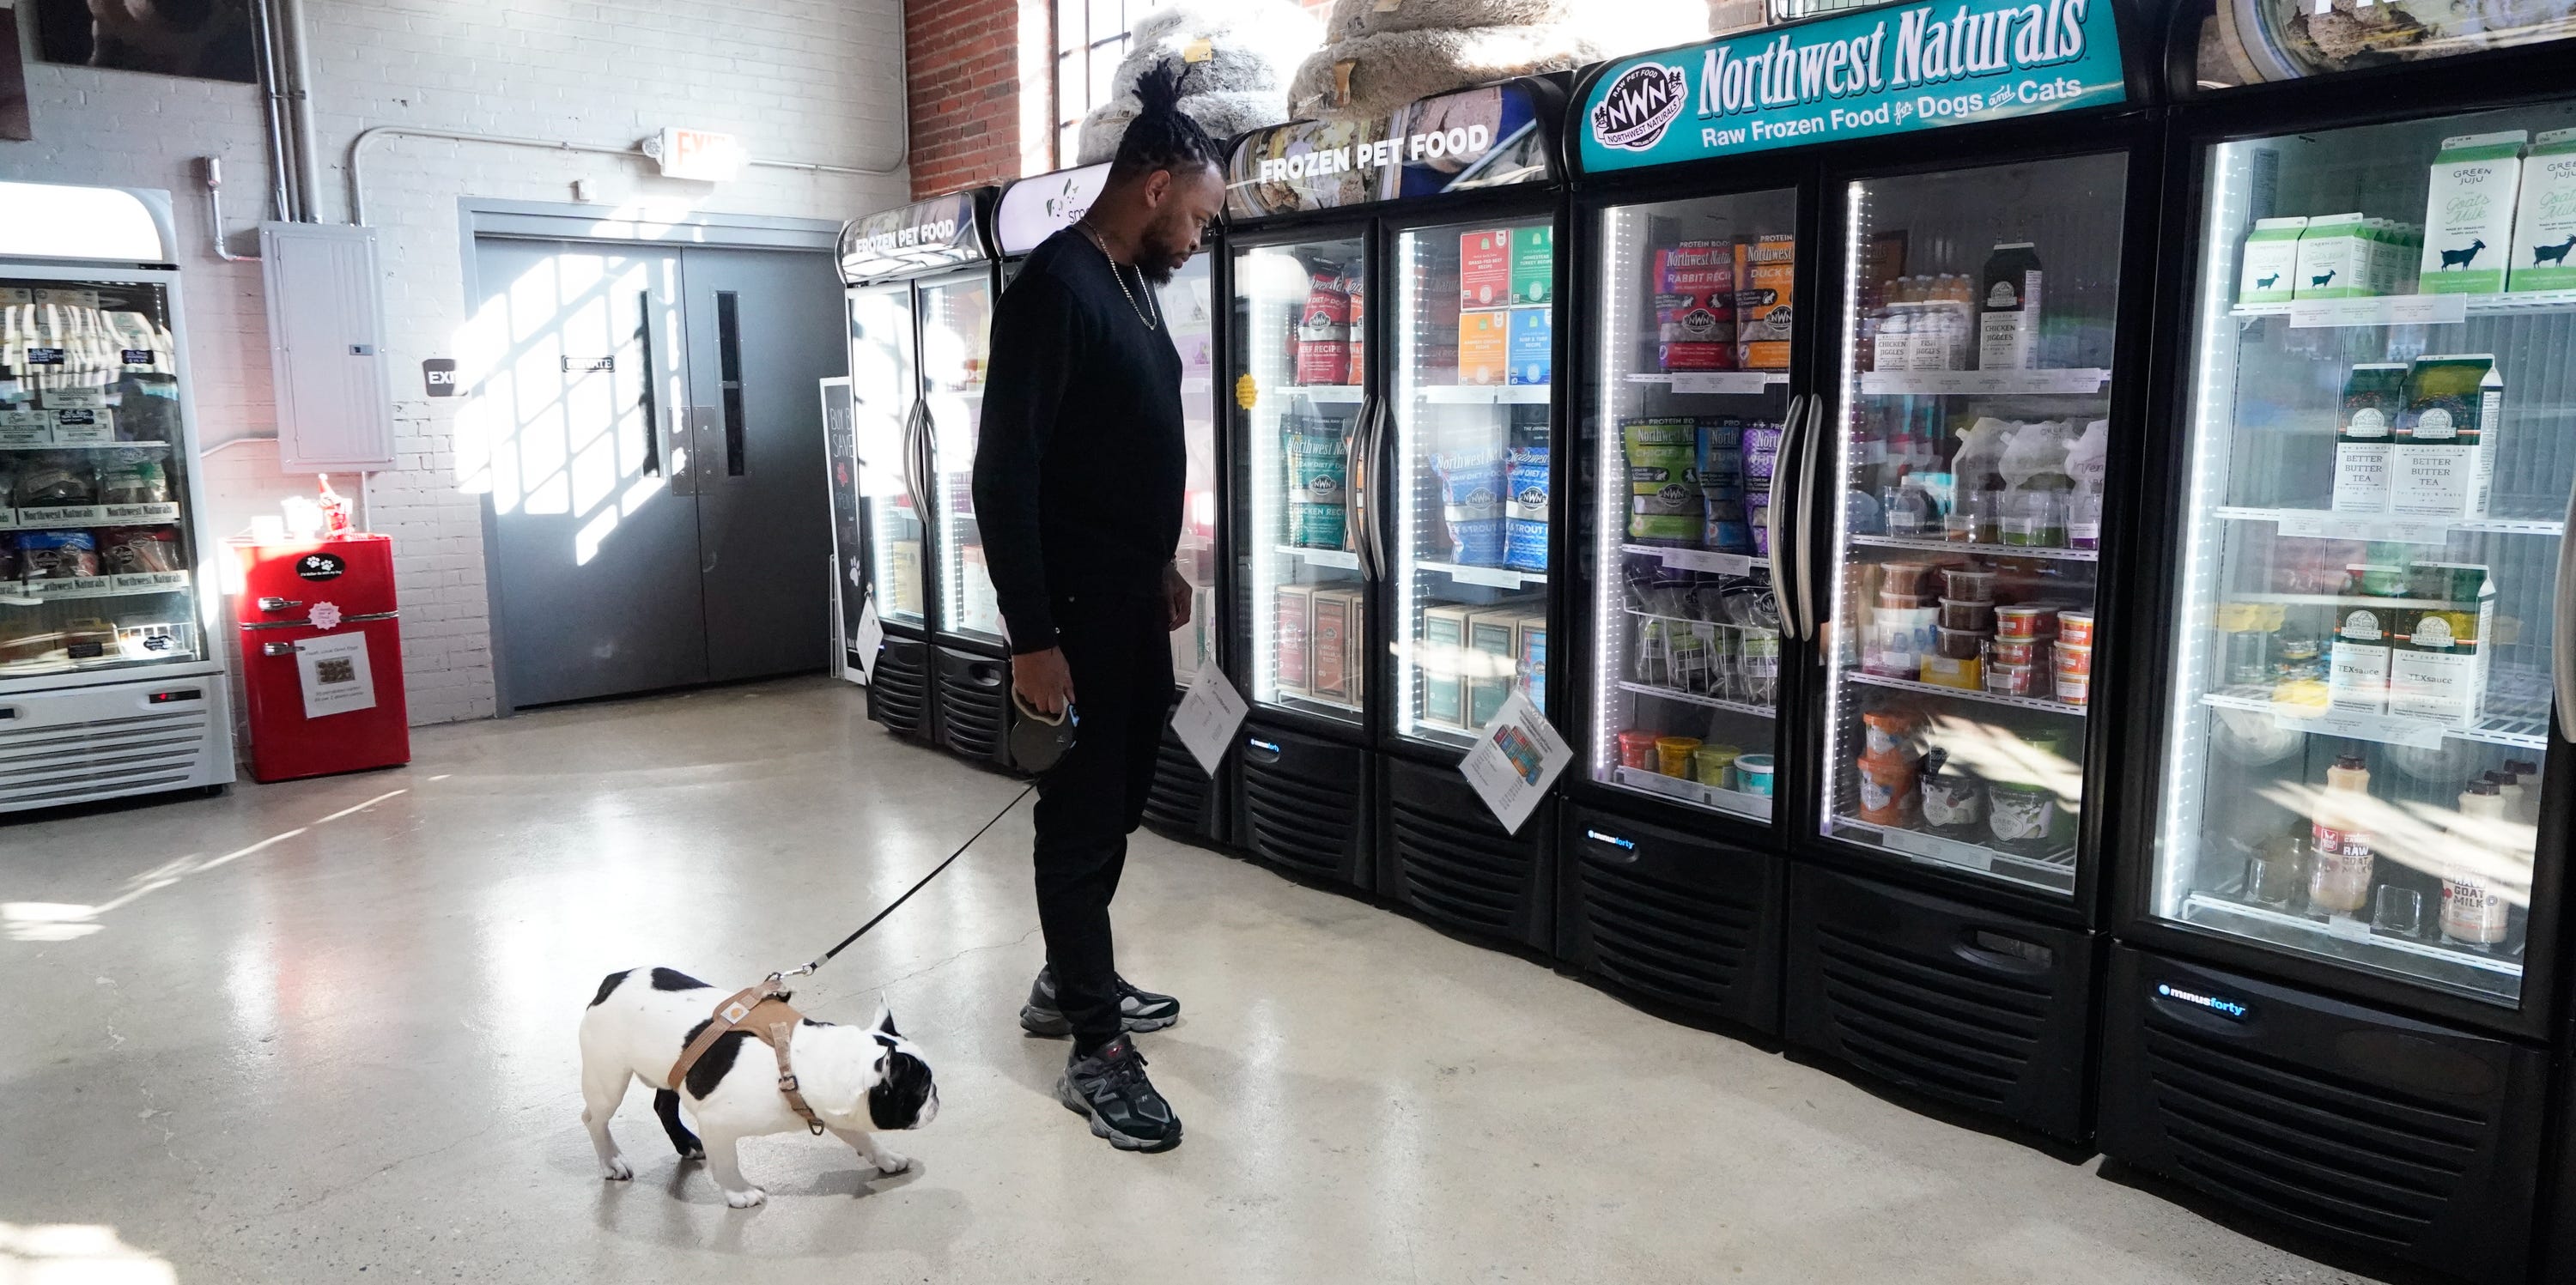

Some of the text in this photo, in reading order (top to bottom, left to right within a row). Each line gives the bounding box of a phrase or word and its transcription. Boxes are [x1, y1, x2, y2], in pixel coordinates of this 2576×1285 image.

[1698, 0, 2087, 118] Northwest Naturals
[1613, 70, 1658, 98] RAW PET FOOD
[1607, 78, 1667, 130] NWN
[1702, 77, 2082, 148] Raw Frozen Food for Dogs and Cats
[1607, 101, 1677, 143] NORTHWEST NATURALS
[1260, 124, 1489, 185] FROZEN PET FOOD
[2453, 168, 2492, 179] GREEN
[2459, 176, 2484, 185] JUJU
[2447, 192, 2491, 210] Goat's
[2540, 190, 2576, 209] Goat
[2445, 209, 2487, 225] Milk
[856, 219, 955, 254] FROZEN PET FOOD
[1667, 251, 1709, 266] Northwest
[1747, 245, 1793, 263] Northwest
[1668, 273, 1704, 283] RABBIT
[1751, 268, 1783, 278] DUCK
[1688, 316, 1710, 325] NWN
[1315, 345, 1341, 354] RECIPE
[428, 370, 457, 385] EXI
[830, 409, 844, 430] BUY
[1711, 430, 1737, 445] North
[832, 433, 854, 458] SAVE
[1288, 437, 1332, 455] Northwest
[1437, 453, 1485, 470] Northwest
[1314, 479, 1331, 488] NWN
[1523, 492, 1542, 503] NWN
[1664, 488, 1684, 498] NWN
[24, 510, 61, 521] Northwest
[106, 504, 173, 517] Northwest Naturals
[1516, 525, 1543, 534] TROUT
[117, 574, 182, 588] Northwest Naturals
[2337, 665, 2379, 676] TEXsauce
[2409, 673, 2453, 684] TEXsauce
[2343, 846, 2369, 856] RAW
[2454, 886, 2486, 899] GOAT
[2453, 896, 2483, 908] MILK
[2171, 988, 2245, 1015] minusforty
